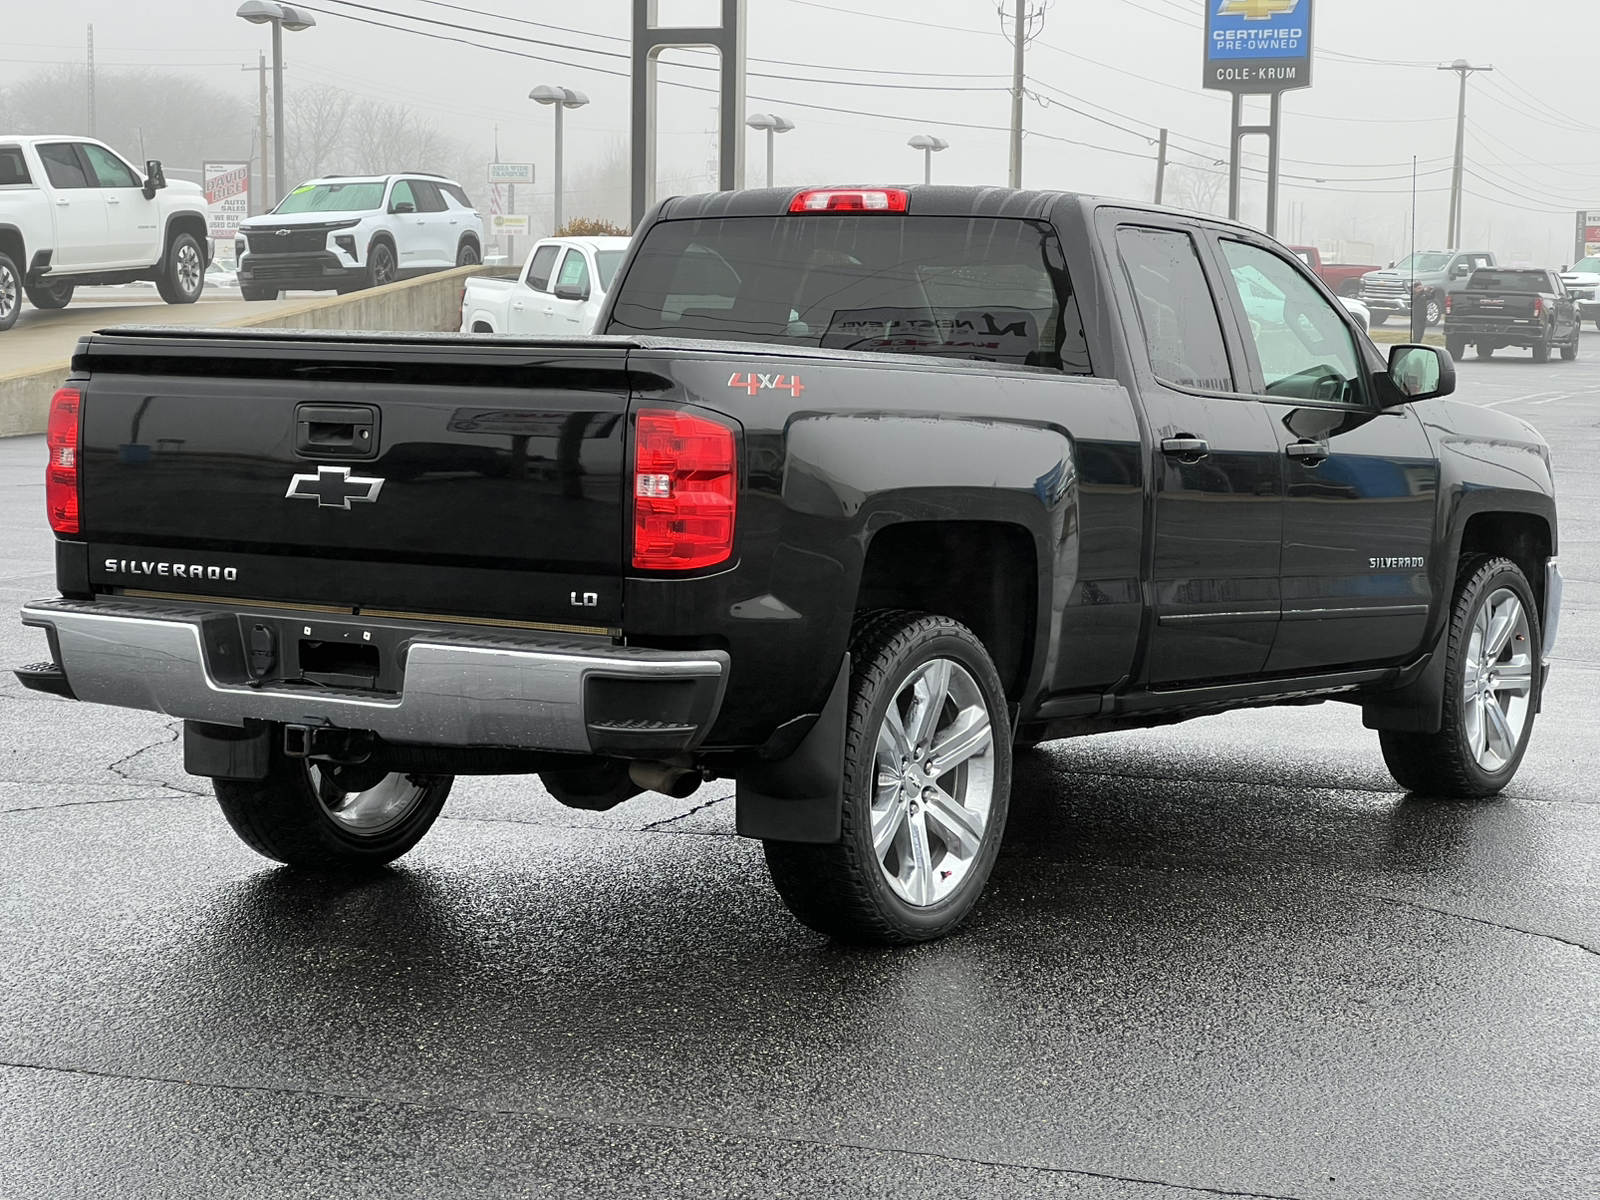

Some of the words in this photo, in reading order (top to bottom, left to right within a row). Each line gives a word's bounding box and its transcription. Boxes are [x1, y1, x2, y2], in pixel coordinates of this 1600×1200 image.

[1213, 28, 1302, 40] CERTIFIED
[1217, 39, 1297, 50] PRE-OWNED
[206, 168, 246, 192] DAVID
[213, 182, 243, 201] RICE
[105, 559, 237, 581] SILVERADO
[1369, 557, 1424, 568] SILVERADO
[571, 591, 598, 606] LD
